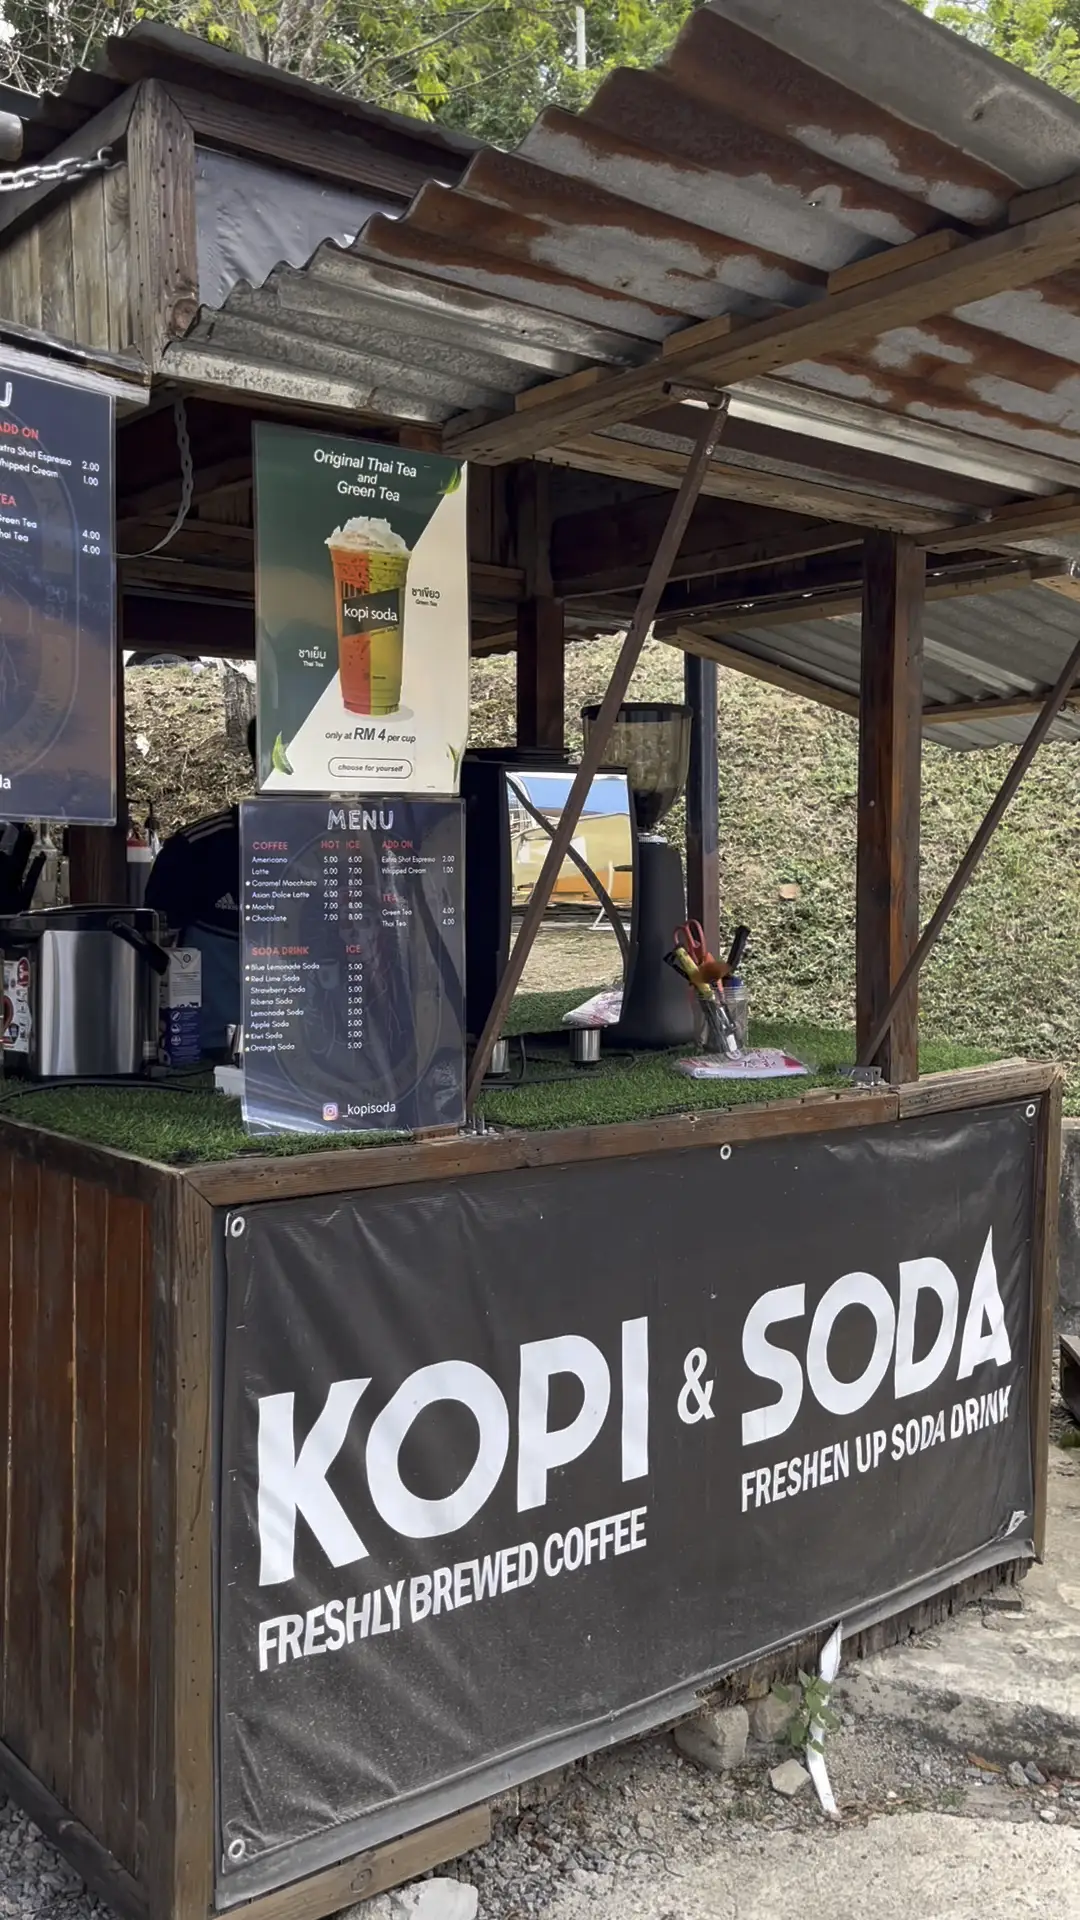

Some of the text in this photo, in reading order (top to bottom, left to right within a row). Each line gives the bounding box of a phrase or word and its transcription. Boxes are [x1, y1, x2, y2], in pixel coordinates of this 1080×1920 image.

[22, 426, 38, 440] ON
[0, 444, 99, 472] xtra Shot Espresso 2.00
[314, 449, 417, 477] Original Thai Tea
[32, 464, 58, 478] Cream
[83, 475, 98, 487] 1.00
[357, 473, 378, 485] and
[337, 480, 400, 502] Green Tea
[0, 493, 16, 507] EA
[22, 517, 37, 529] Tea
[82, 529, 100, 541] 4.00
[0, 529, 100, 555] hai Tea 4.00
[344, 603, 398, 622] kopi soda
[298, 646, 327, 660] ชาเย็น
[325, 727, 416, 743] only at RM 4 per cup
[338, 763, 404, 773] choose for yourself
[327, 809, 394, 831] MENU
[252, 840, 361, 851] COFFEE HOT ICE
[382, 841, 413, 849] ADD ON
[323, 855, 339, 863] 5.00
[348, 855, 363, 863] 6.00
[412, 856, 436, 864] Espresso
[442, 855, 455, 863] 2.00
[323, 867, 339, 875] 6.00
[348, 867, 363, 875] 7.00
[381, 867, 407, 875] Whipped
[251, 879, 281, 887] Caramel
[282, 879, 318, 887] Macchiato
[348, 878, 363, 886] 8.00
[251, 890, 363, 899] Asian Dolce Latte 6.00 7.00
[323, 902, 339, 910] 7.00
[348, 901, 363, 909] 8.00
[251, 913, 363, 922] Chocolate 7.00 8.00
[381, 908, 400, 916] Green
[251, 944, 361, 956] SODA DRINK ICE
[251, 962, 363, 971] Blue Lemonade Soda 5.00
[250, 974, 363, 982] Red Lime Soda 5.00
[250, 986, 287, 994] Strawberry
[288, 985, 306, 993] Soda
[250, 1008, 363, 1017] Lemonade Soda 5.00
[250, 1021, 270, 1029] Apple
[271, 1020, 289, 1028] Soda
[251, 1032, 264, 1040] Kiwi
[265, 1031, 283, 1039] Soda
[250, 1044, 276, 1053] Orange
[277, 1042, 295, 1050] Soda
[342, 1101, 396, 1118] _kopisoda
[257, 1226, 1012, 1587] KOPI & SODA
[741, 1385, 1011, 1513] FRESHEN UP SODA DRINK
[258, 1505, 648, 1672] FRESHLY BREWED COFFEE
